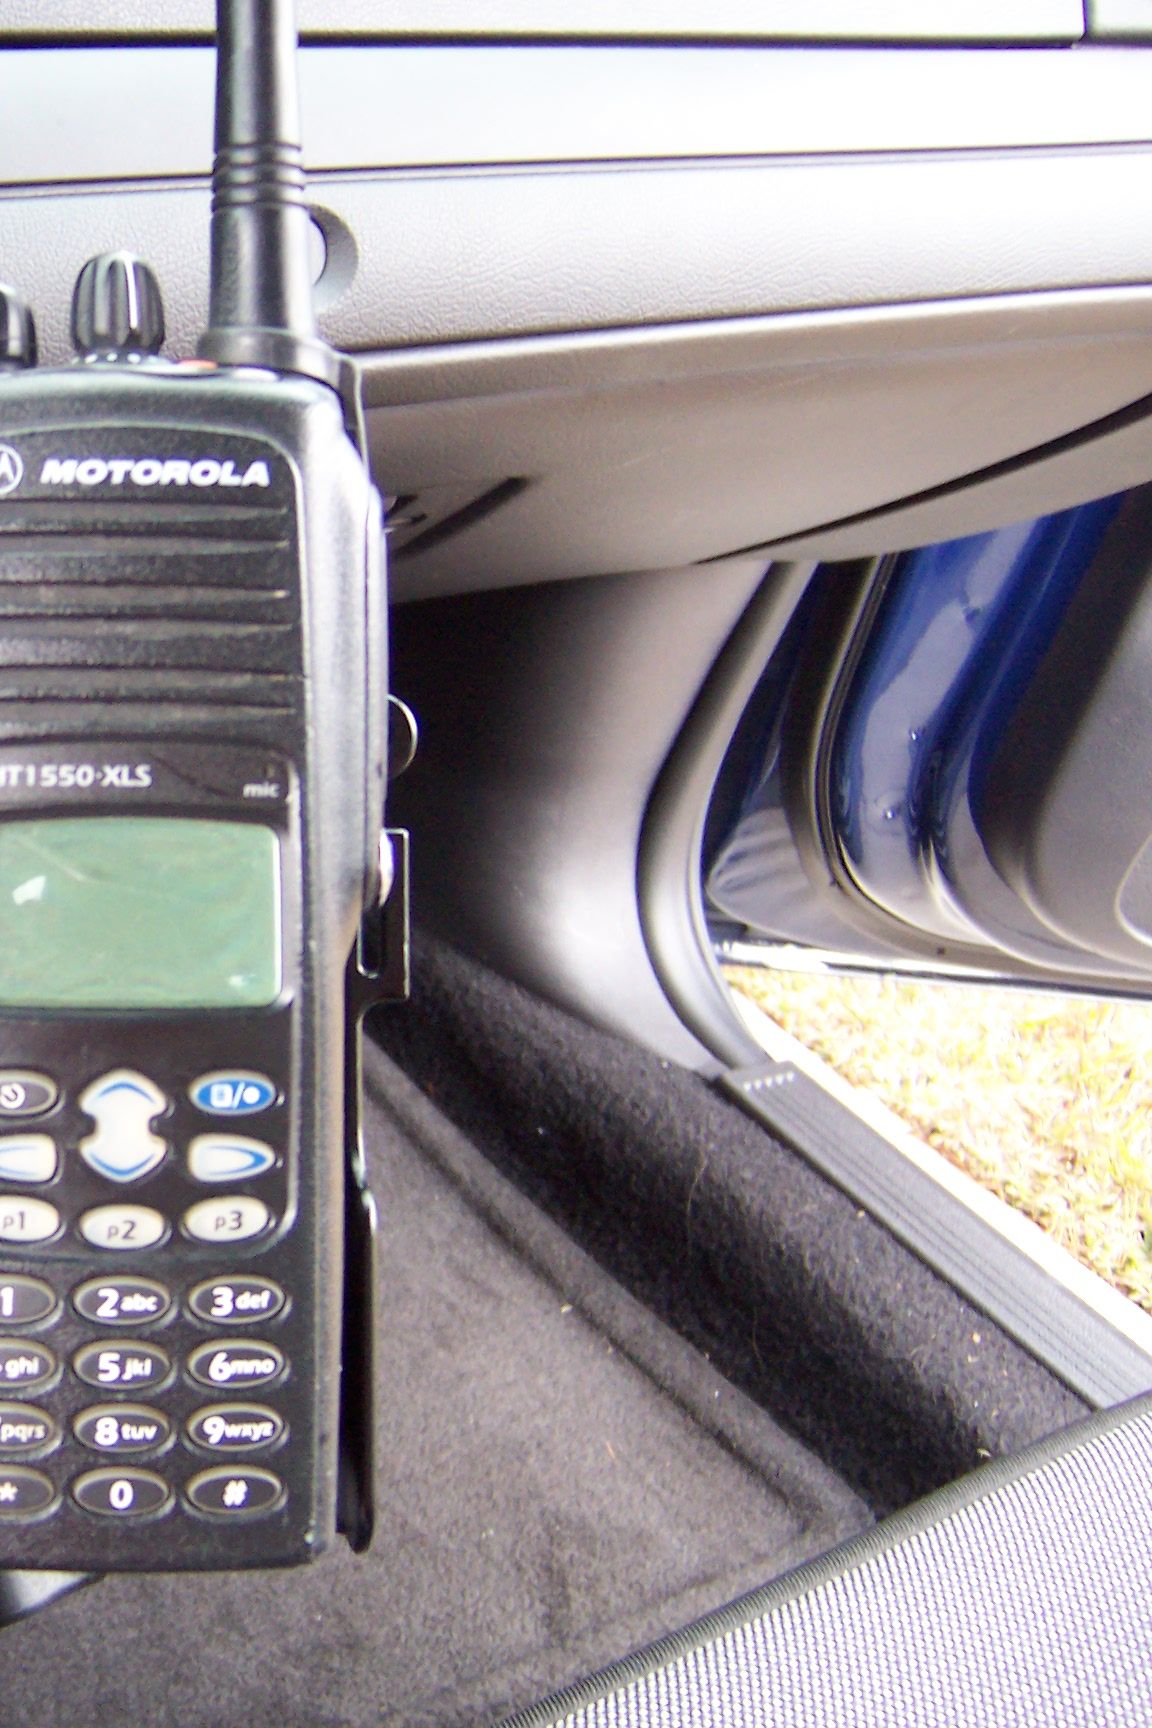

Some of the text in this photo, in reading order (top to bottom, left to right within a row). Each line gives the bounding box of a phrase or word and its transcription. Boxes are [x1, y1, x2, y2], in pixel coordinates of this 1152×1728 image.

[40, 458, 270, 488] MOTOROLA
[243, 781, 279, 799] mic
[2, 1211, 26, 1231] p1
[107, 1220, 137, 1241] p2
[214, 1210, 243, 1231] p3
[0, 1286, 15, 1317] 1
[109, 1480, 134, 1510] 0
